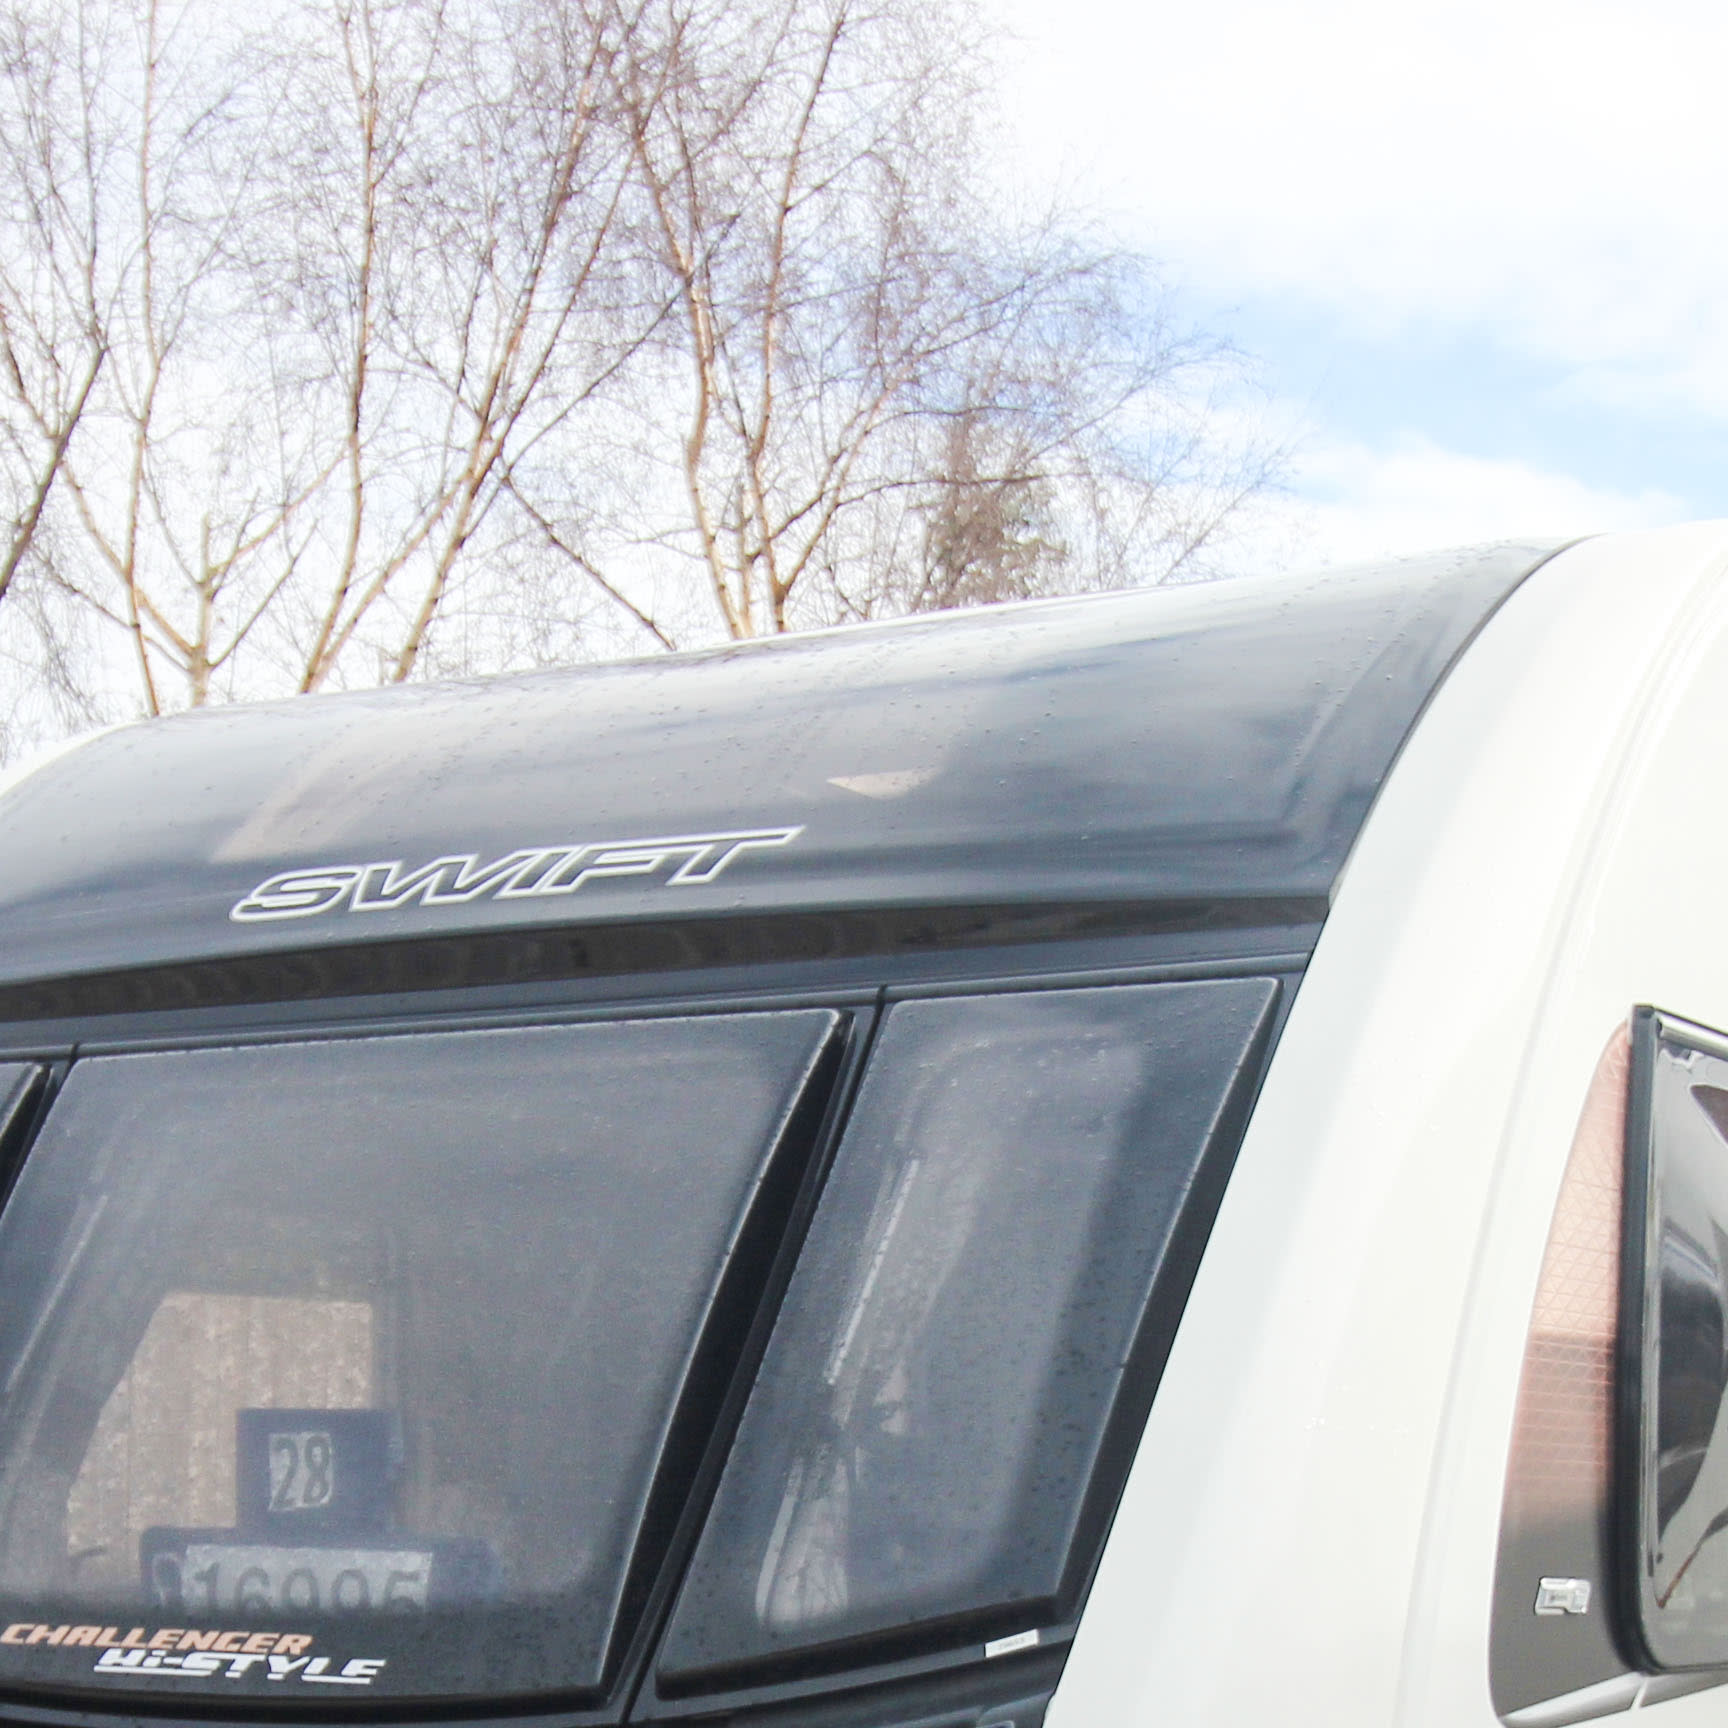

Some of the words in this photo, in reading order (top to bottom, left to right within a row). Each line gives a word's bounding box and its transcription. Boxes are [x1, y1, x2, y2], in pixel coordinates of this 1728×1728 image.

[228, 825, 806, 921] SWIFT
[272, 1437, 330, 1510] 28
[0, 1624, 313, 1656] CHALLENGER
